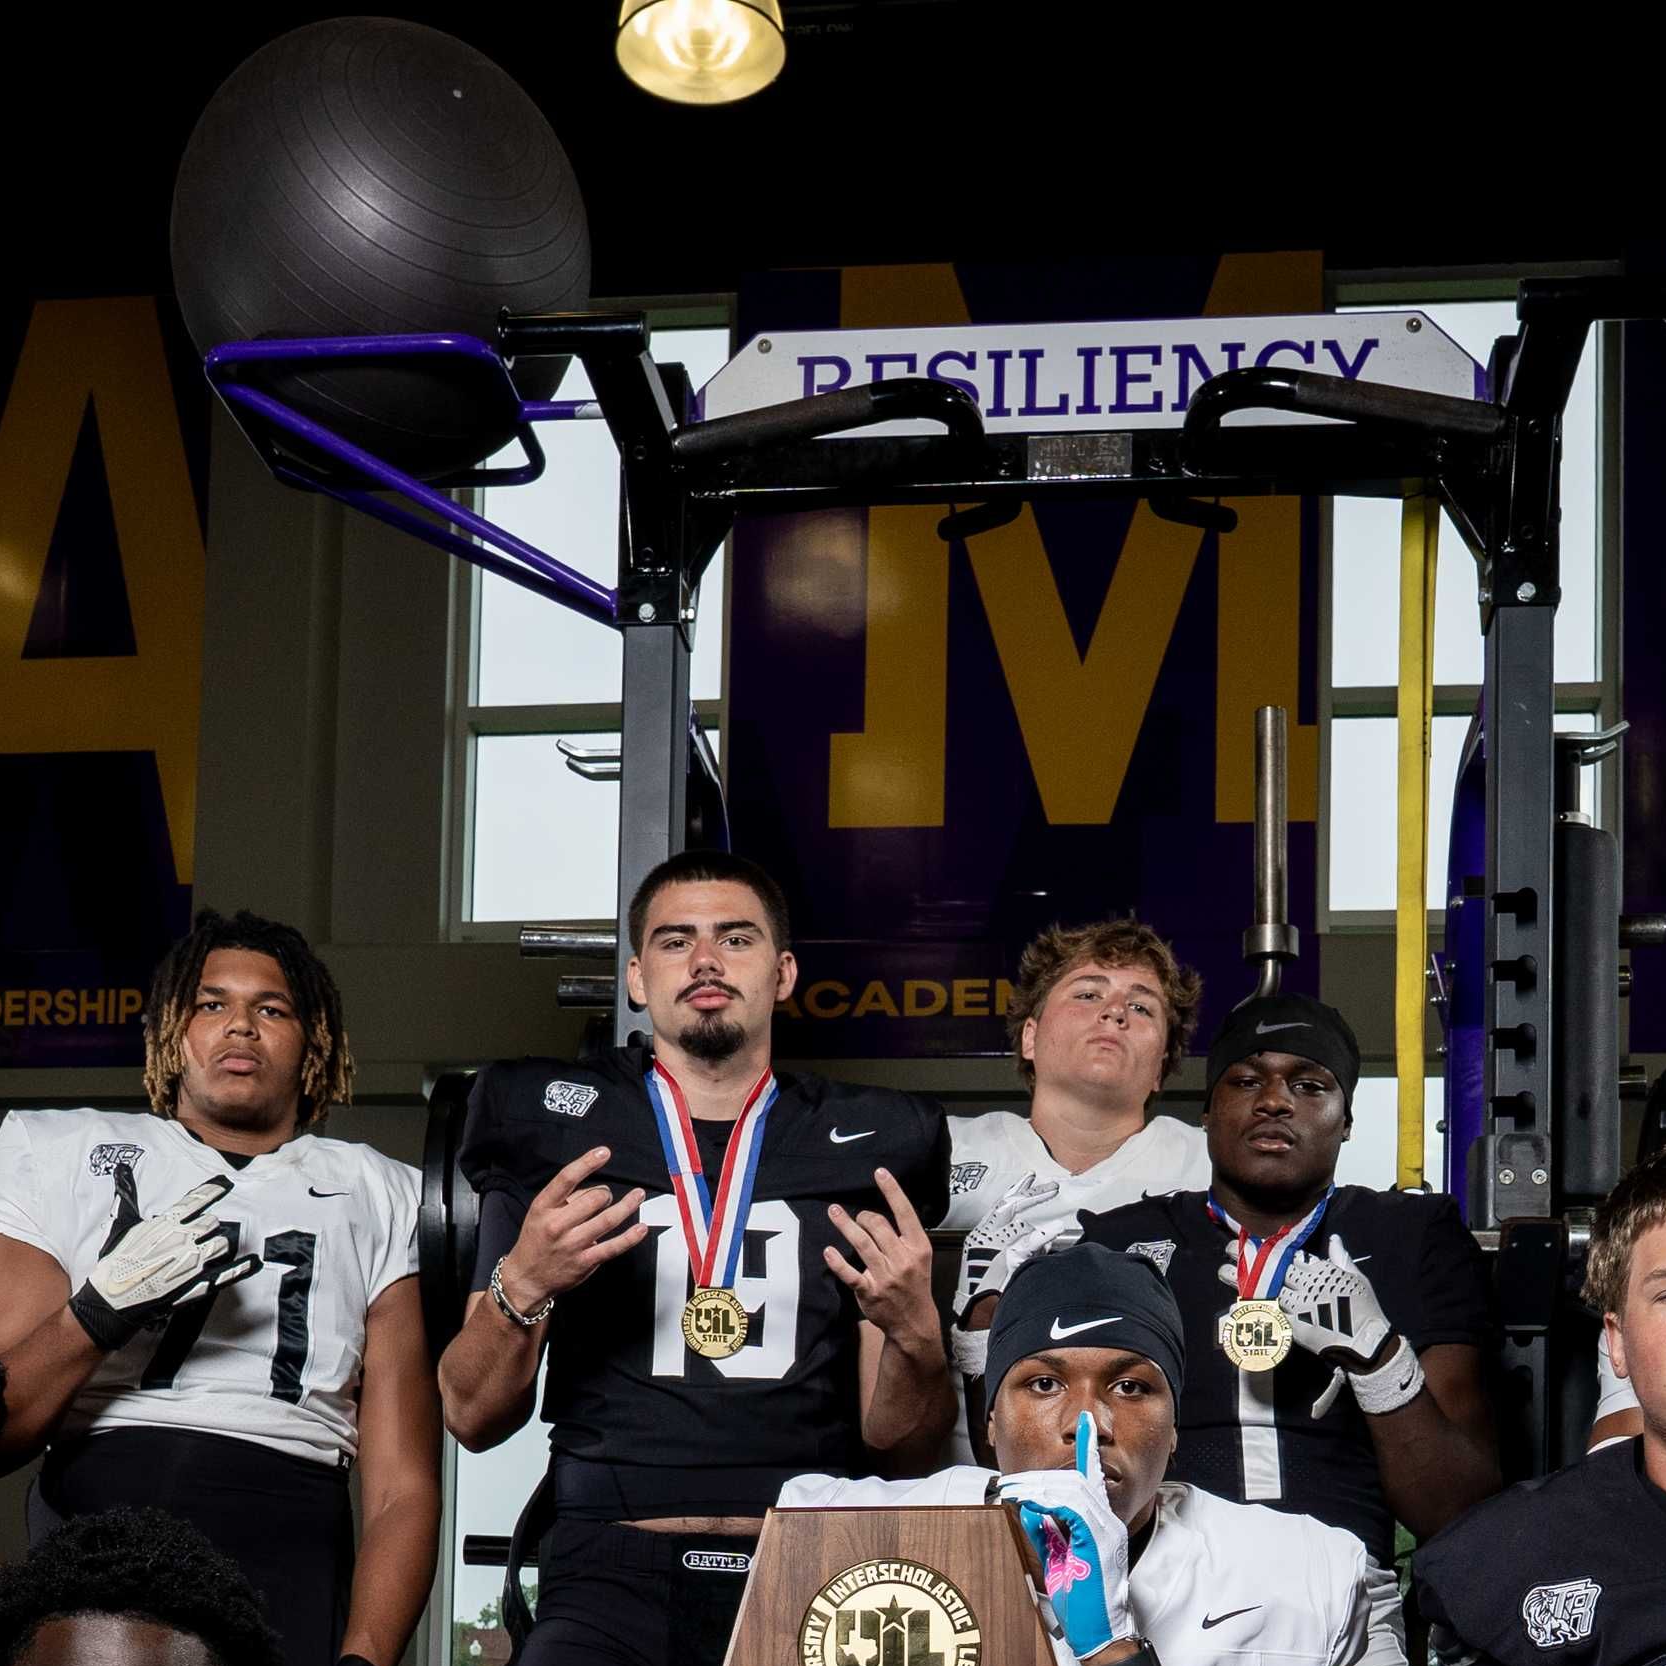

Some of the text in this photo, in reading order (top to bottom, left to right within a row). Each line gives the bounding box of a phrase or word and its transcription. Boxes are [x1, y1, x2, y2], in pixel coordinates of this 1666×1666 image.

[829, 249, 1320, 827] M
[639, 1194, 800, 1379] 19
[1243, 1348, 1269, 1357] STATE
[689, 1554, 746, 1568] BATTLE
[826, 1563, 973, 1630] INTERSCHOLASTIC
